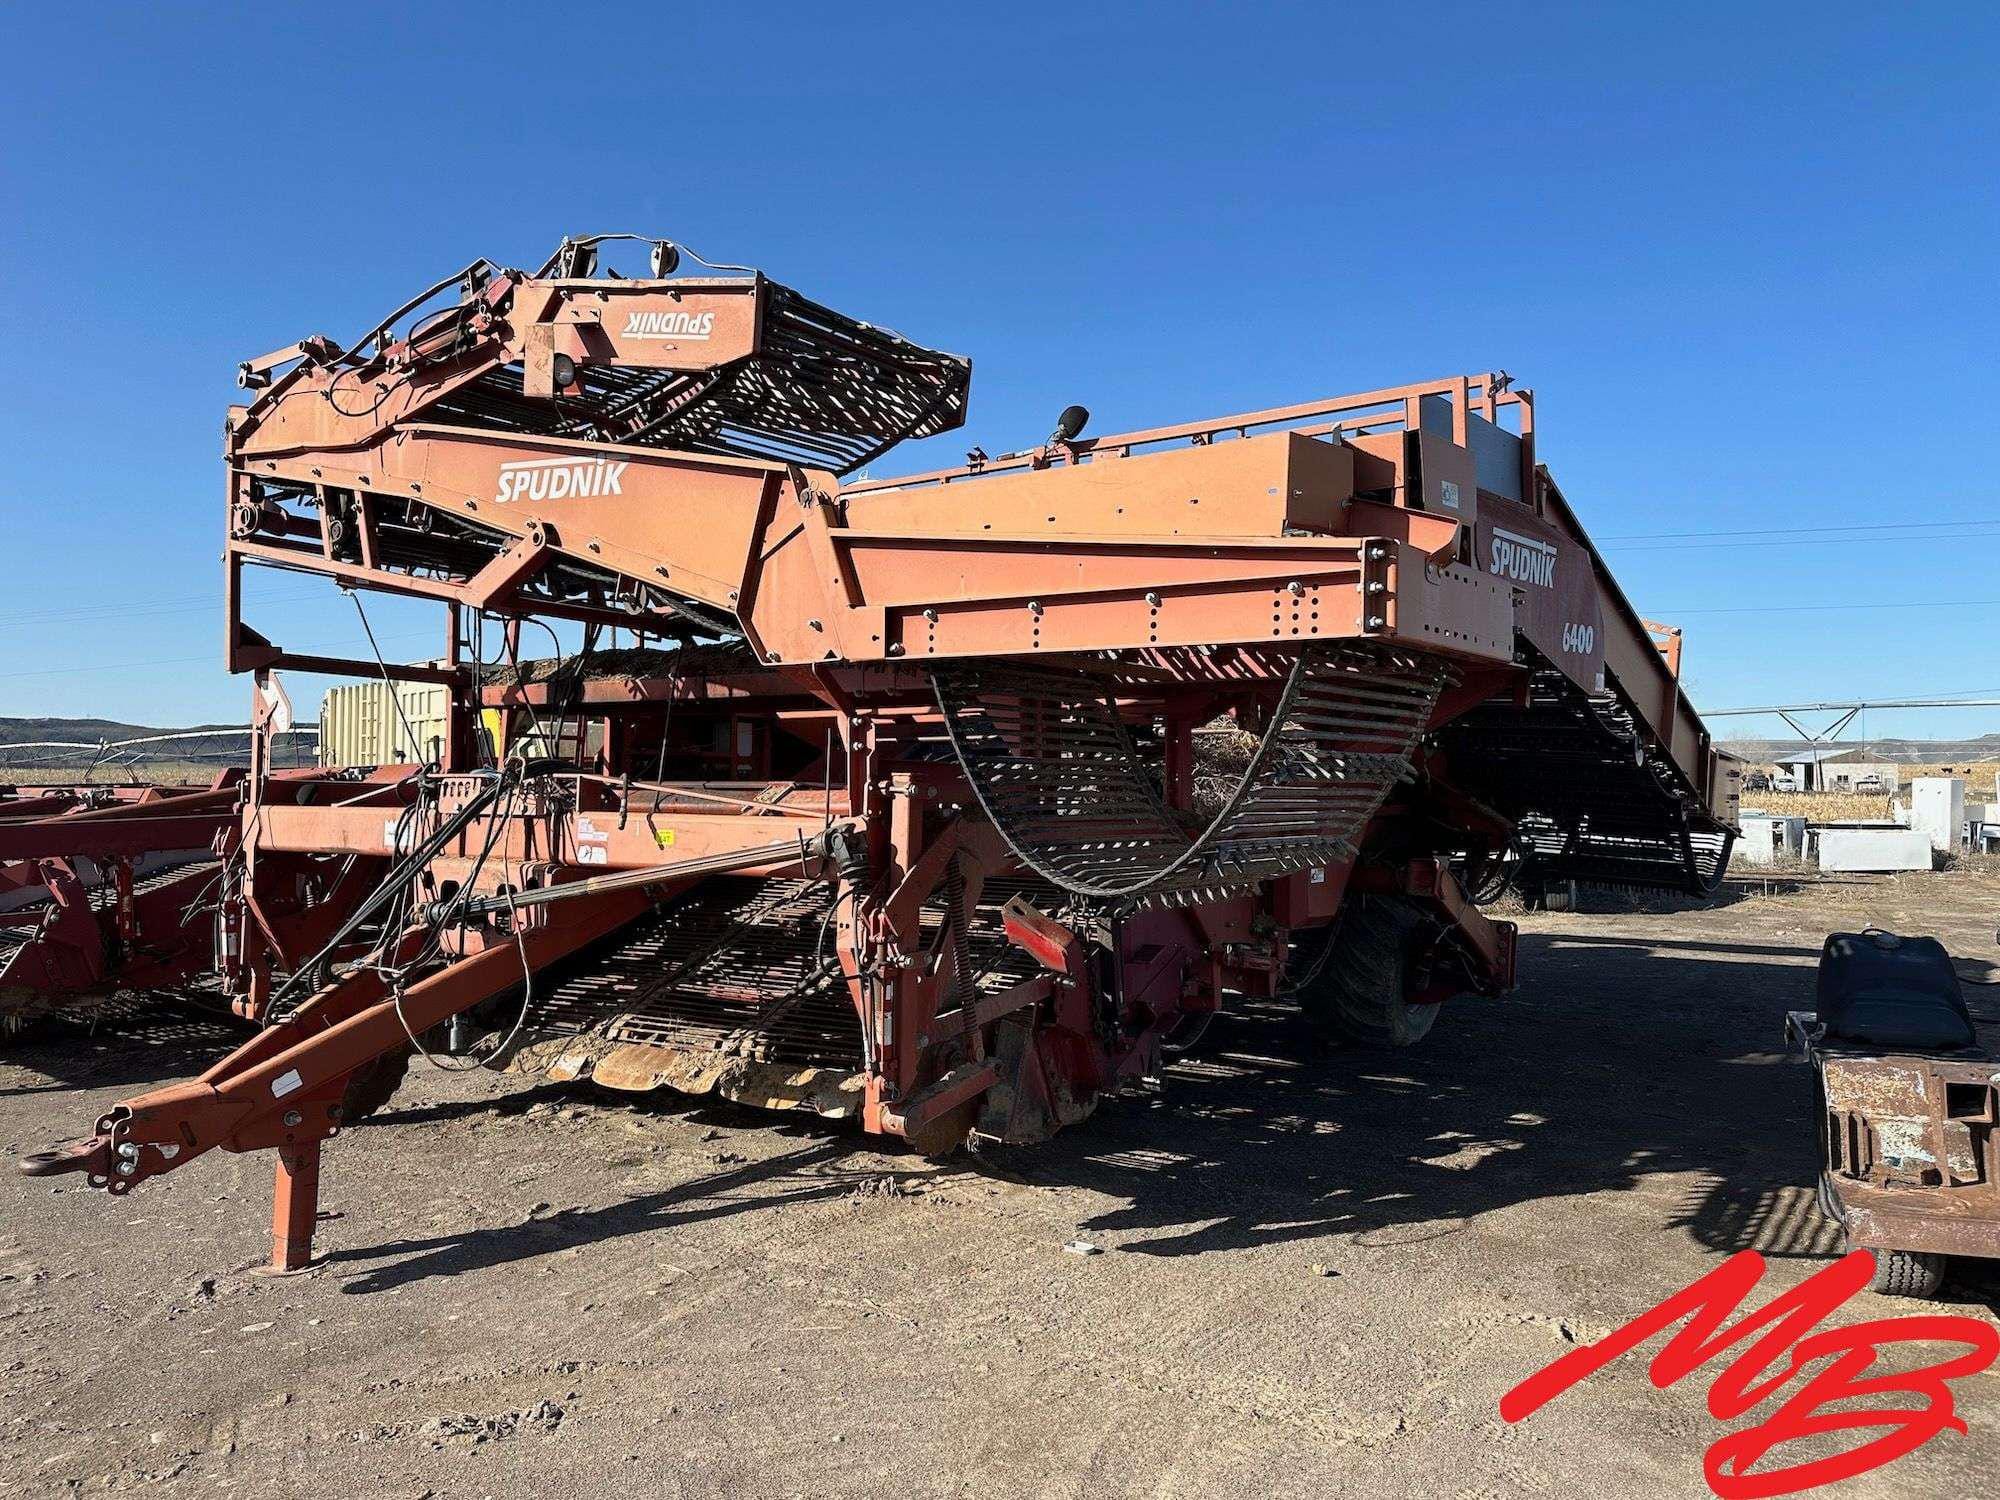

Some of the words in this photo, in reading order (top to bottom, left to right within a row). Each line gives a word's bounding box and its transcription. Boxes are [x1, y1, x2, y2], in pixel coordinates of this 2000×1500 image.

[622, 312, 715, 338] SPUDNIK
[495, 460, 629, 503] SPUDNIK
[1489, 534, 1558, 589] SPUDNIK
[1562, 622, 1595, 656] 6400
